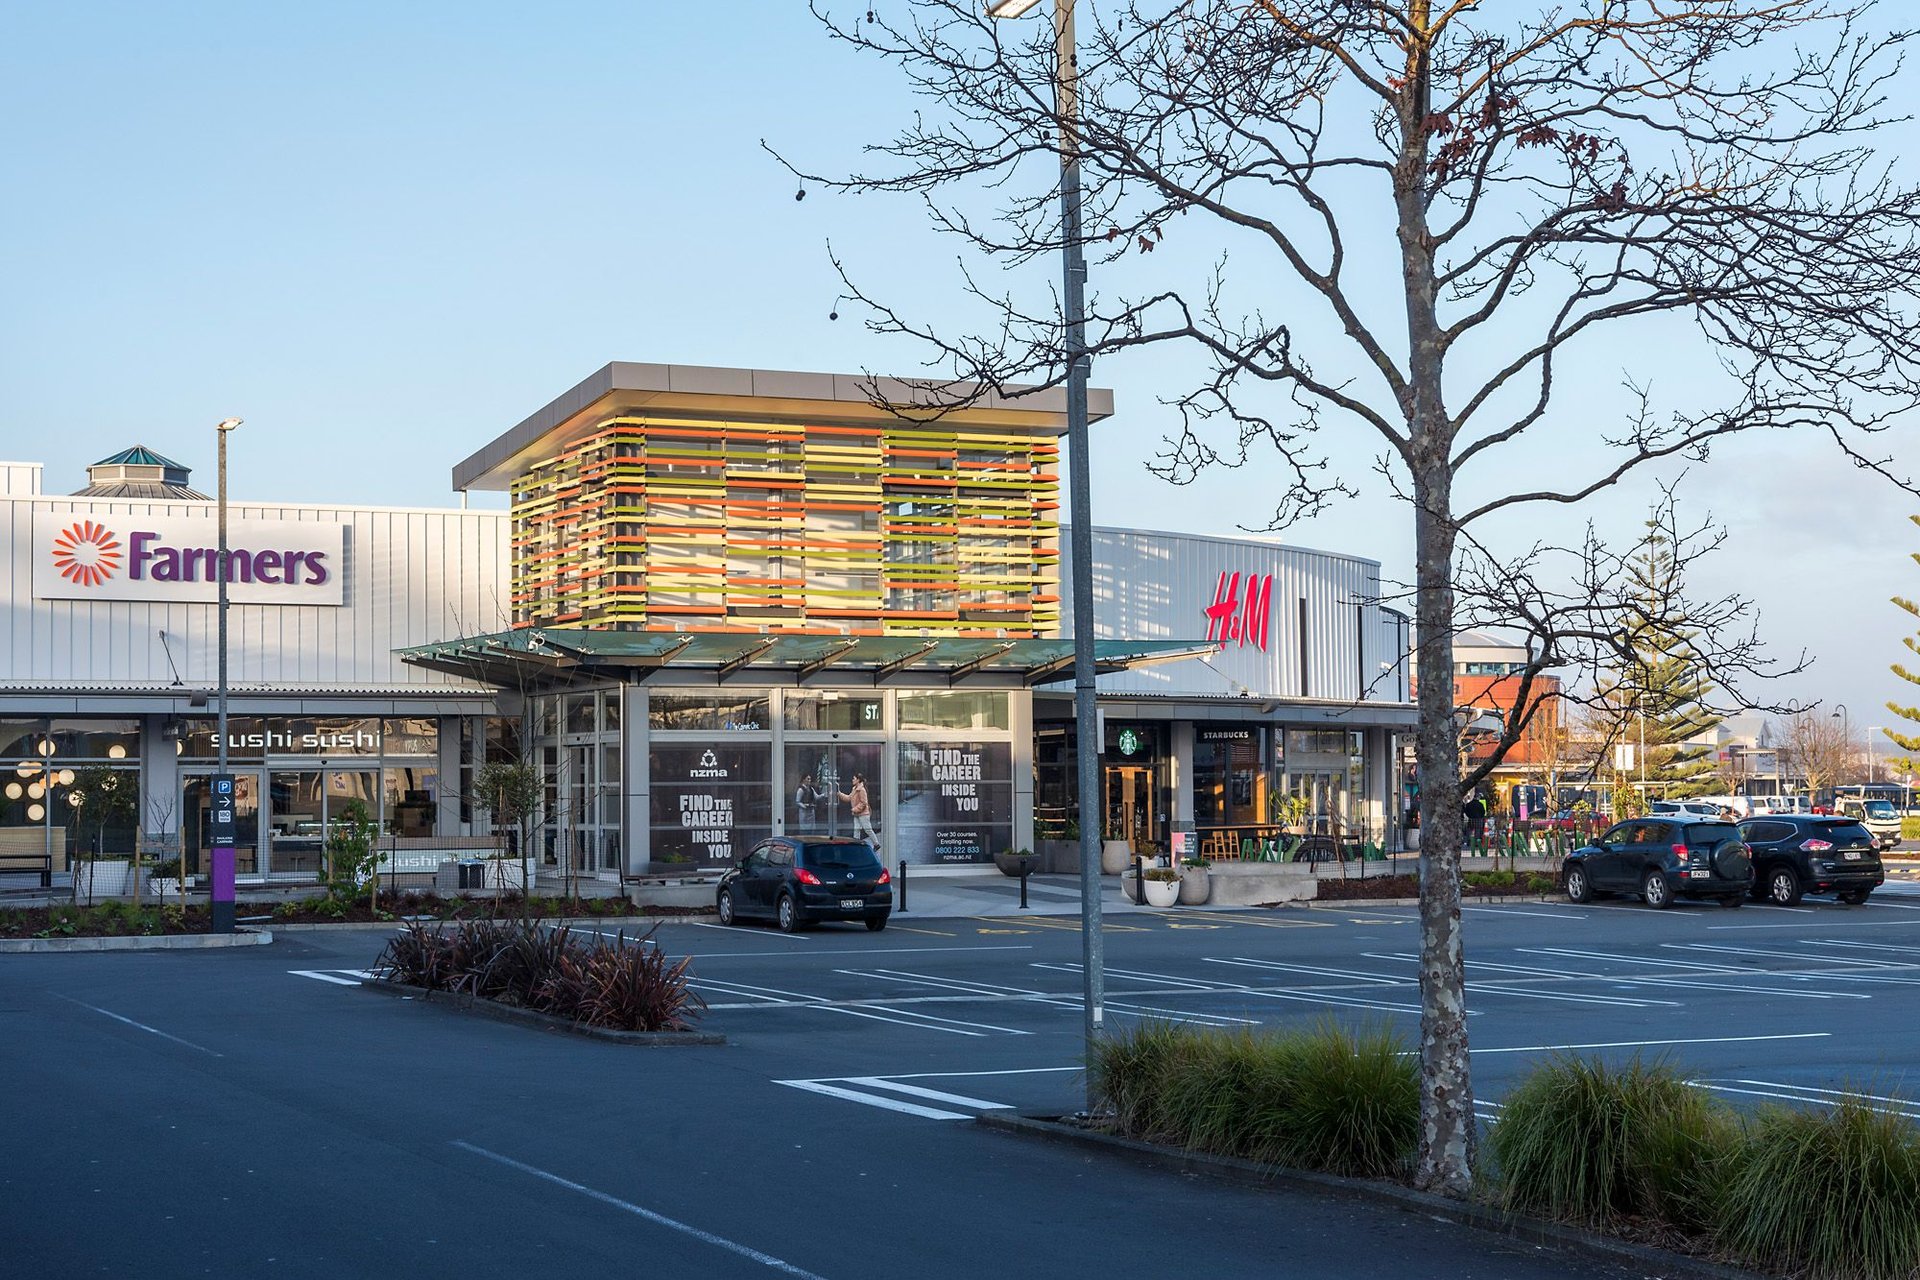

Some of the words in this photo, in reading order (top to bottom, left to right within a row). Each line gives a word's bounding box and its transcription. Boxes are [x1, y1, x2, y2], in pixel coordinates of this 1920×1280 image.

[129, 531, 329, 586] Farmers
[1204, 571, 1272, 653] H&M
[865, 704, 879, 720] ST
[210, 729, 292, 748] sushi
[302, 729, 381, 748] sushi
[1203, 731, 1249, 739] STARBUCKS
[930, 749, 961, 766] FIND
[962, 754, 980, 765] THE
[689, 769, 728, 777] nzma
[932, 765, 981, 780] CAREER
[941, 784, 976, 796] INSIDE
[679, 795, 713, 811] FIND
[714, 799, 733, 810] THE
[956, 797, 979, 811] YOU
[681, 811, 733, 827] CAREER
[691, 830, 729, 843] INSIDE
[707, 844, 732, 859] YOU
[935, 846, 952, 854] 0800
[953, 846, 966, 854] 222
[387, 855, 437, 867] sushi
